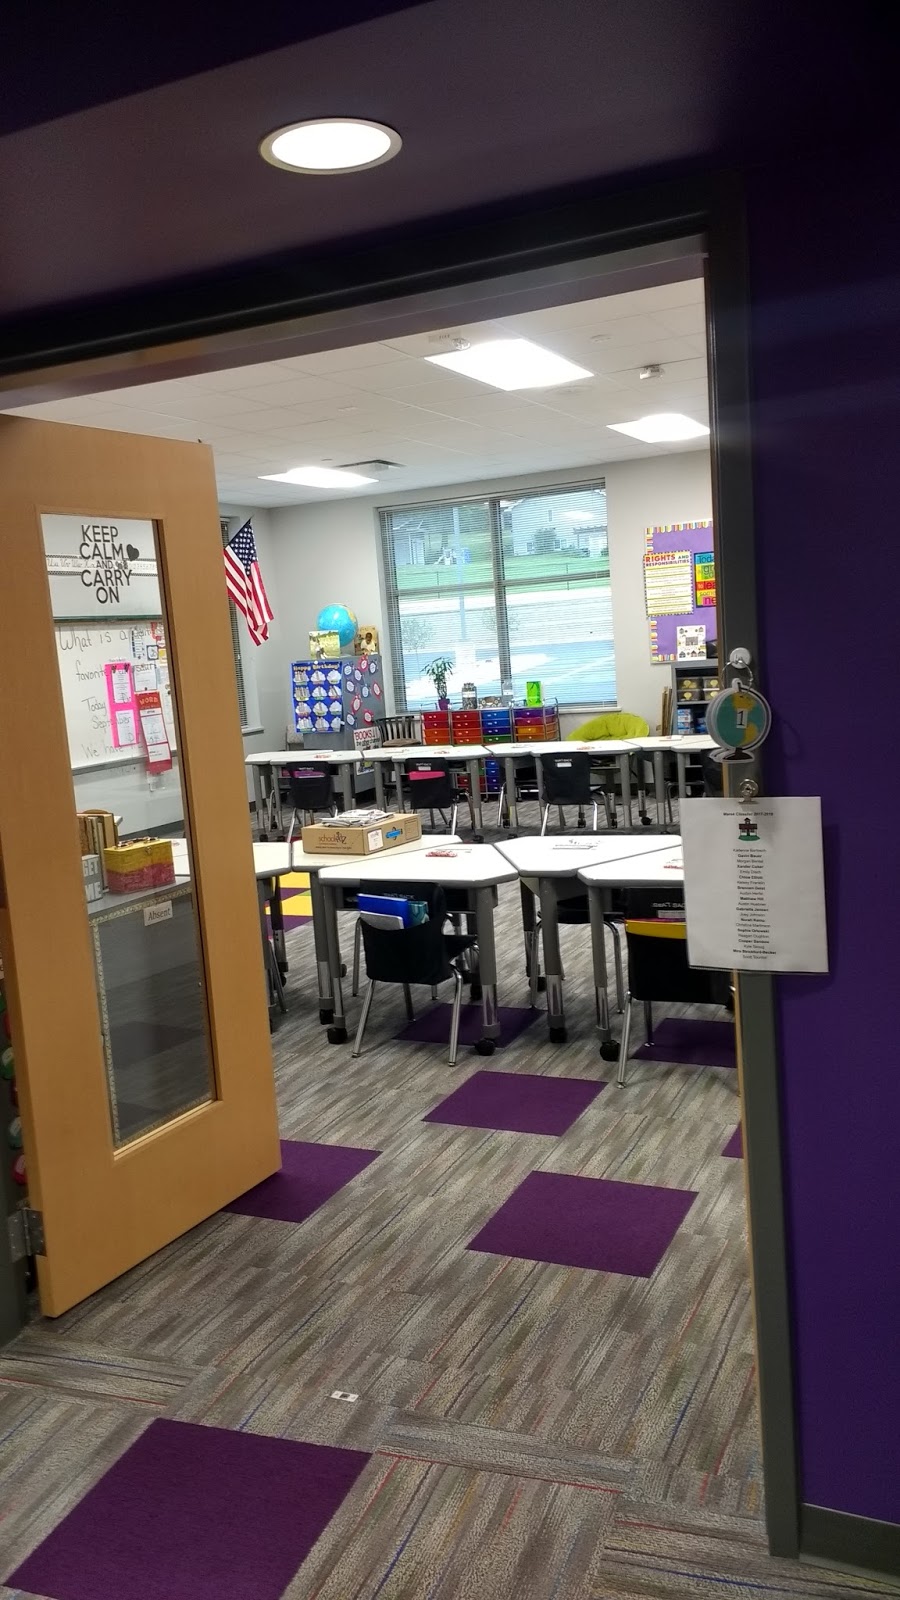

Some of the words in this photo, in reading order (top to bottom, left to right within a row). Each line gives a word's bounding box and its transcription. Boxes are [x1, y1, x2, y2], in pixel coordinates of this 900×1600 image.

[81, 524, 118, 543] KEEP
[79, 542, 127, 560] CALM
[645, 553, 676, 563] RIGHTS
[697, 554, 714, 564] Tod
[96, 560, 113, 570] AND
[646, 559, 690, 567] RESPONSIBILITIES
[81, 569, 132, 587] CARRY
[96, 586, 120, 604] ON
[59, 624, 92, 652] What
[100, 630, 112, 644] is
[81, 695, 107, 717] Today
[139, 696, 159, 705] WORD
[736, 710, 744, 726] 1
[81, 743, 100, 759] We
[148, 907, 171, 921] Absent
